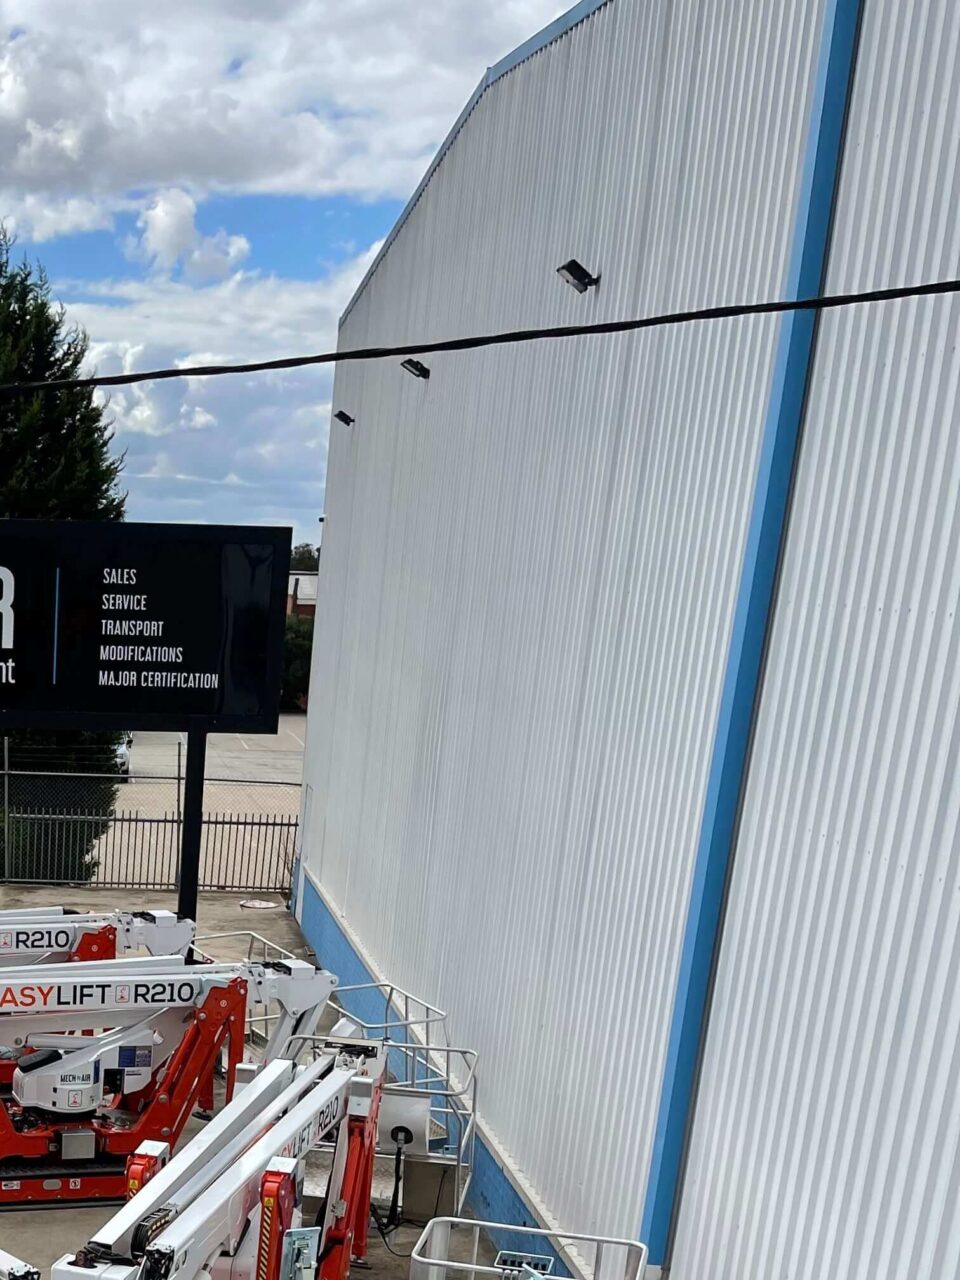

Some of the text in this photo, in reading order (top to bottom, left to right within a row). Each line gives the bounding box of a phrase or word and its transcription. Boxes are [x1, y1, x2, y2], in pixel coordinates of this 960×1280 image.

[103, 568, 137, 584] SALES
[102, 594, 147, 610] SERVICE
[101, 619, 164, 636] TRANSPORT
[100, 645, 183, 662] MODIFICATIONS
[99, 670, 219, 688] MAJOR CERTIFICATION
[16, 930, 70, 949] R210
[134, 983, 194, 1003] R210
[318, 1096, 339, 1136] R210
